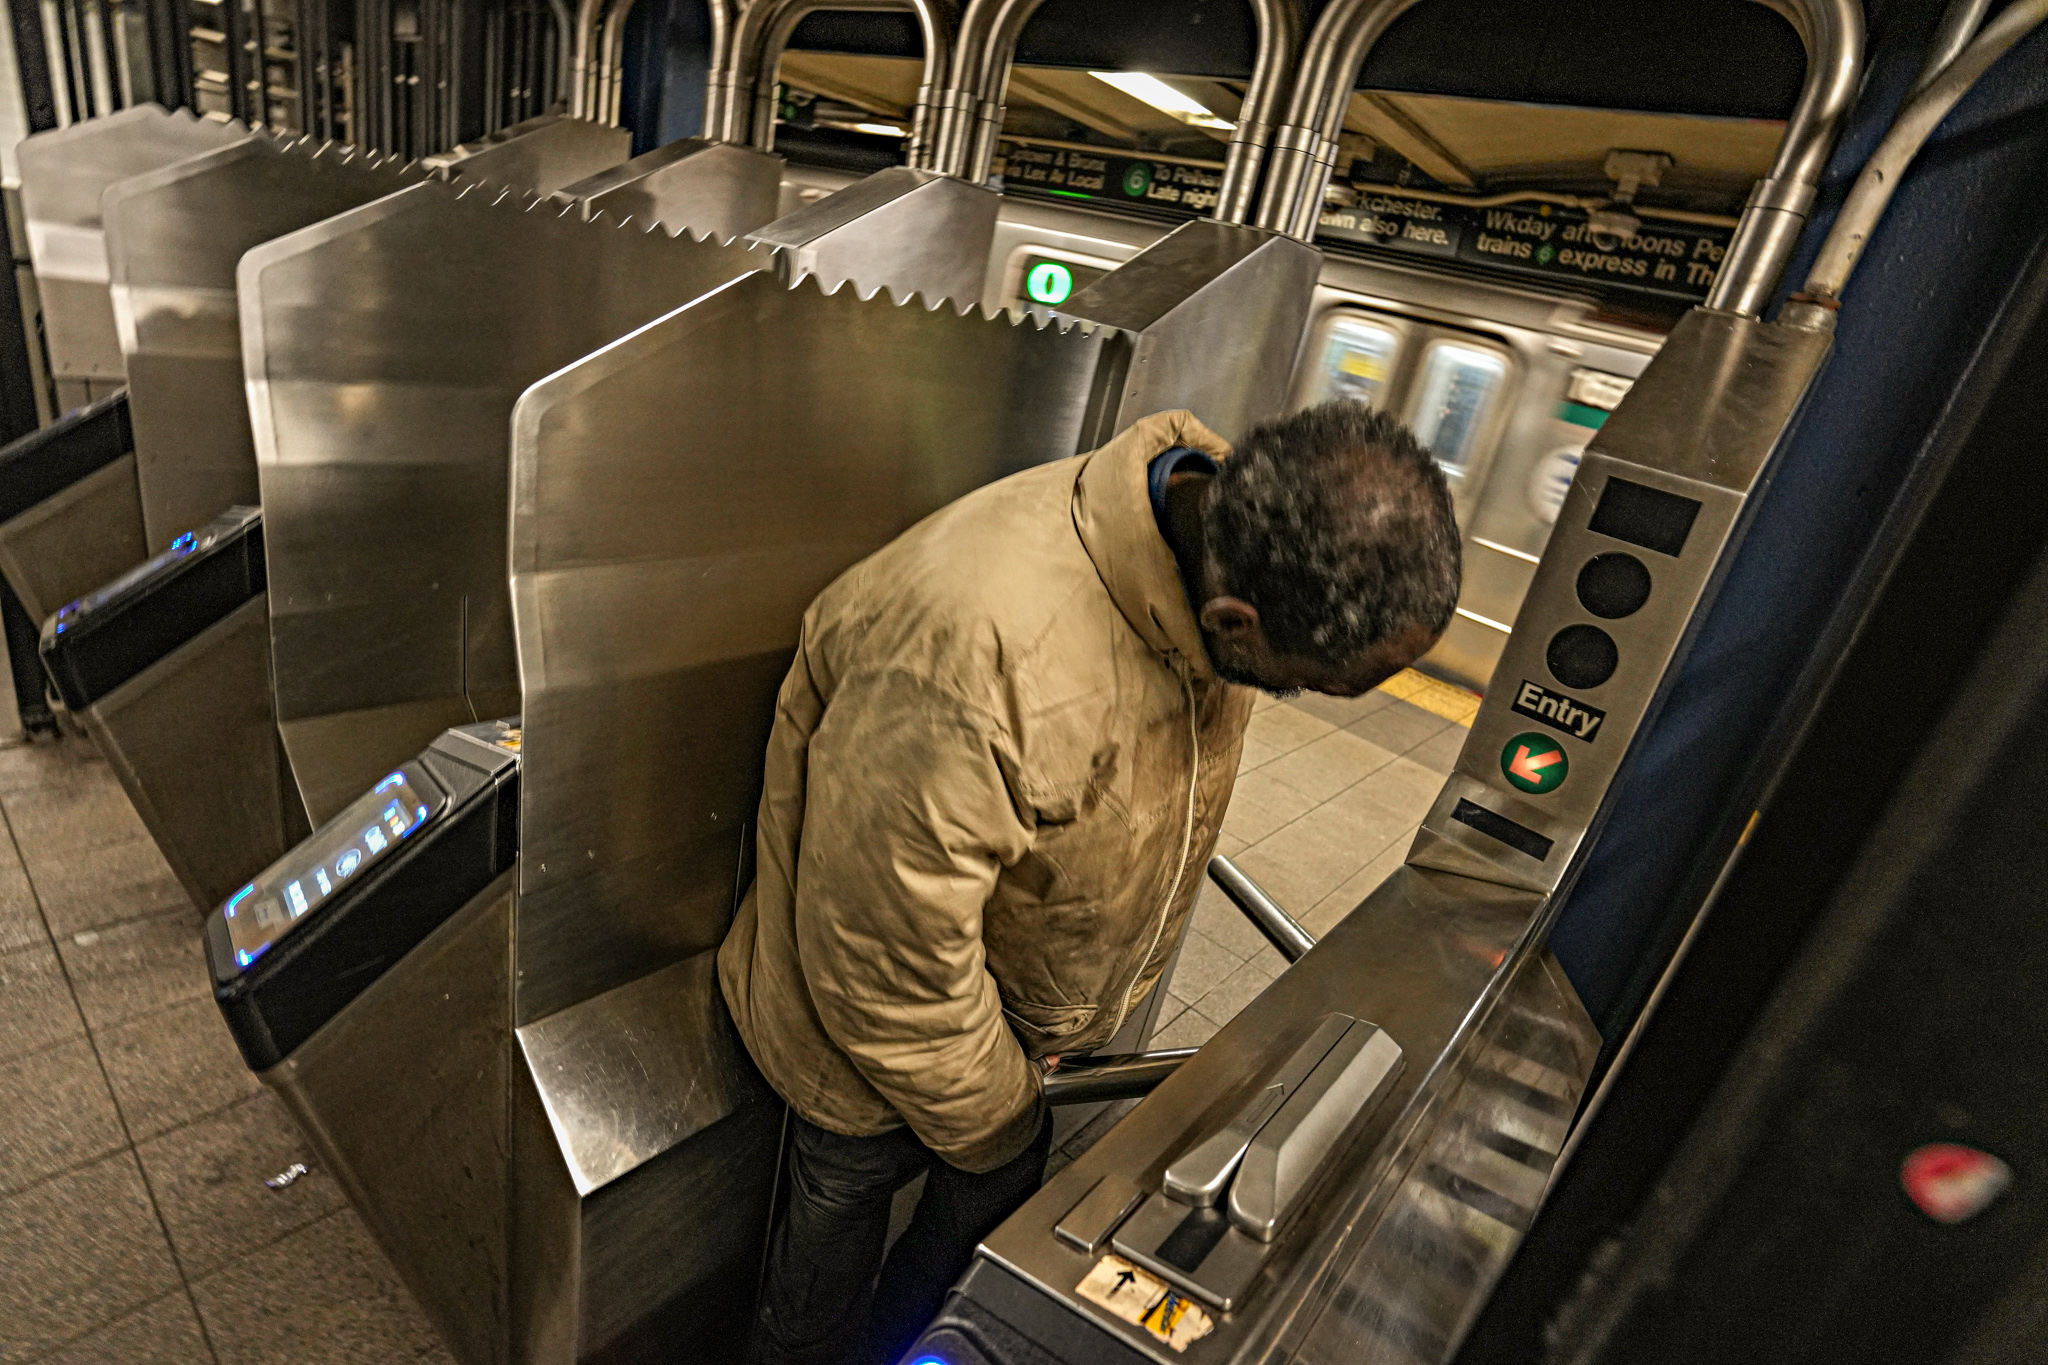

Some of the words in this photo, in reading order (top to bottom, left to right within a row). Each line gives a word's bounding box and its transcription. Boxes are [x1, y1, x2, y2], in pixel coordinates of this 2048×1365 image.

[1066, 170, 1105, 190] Local
[1129, 168, 1145, 189] 6
[1152, 162, 1172, 181] To
[1145, 182, 1181, 202] Late
[1359, 214, 1399, 236] also
[1402, 220, 1449, 246] here.
[1485, 208, 1558, 241] Wkday
[1561, 221, 1688, 258] aftoons
[1692, 237, 1725, 263] Pe
[1476, 232, 1534, 260] trains
[1558, 248, 1649, 279] express
[1654, 257, 1678, 282] in
[1687, 261, 1717, 287] Th
[1517, 682, 1601, 738] Entry
